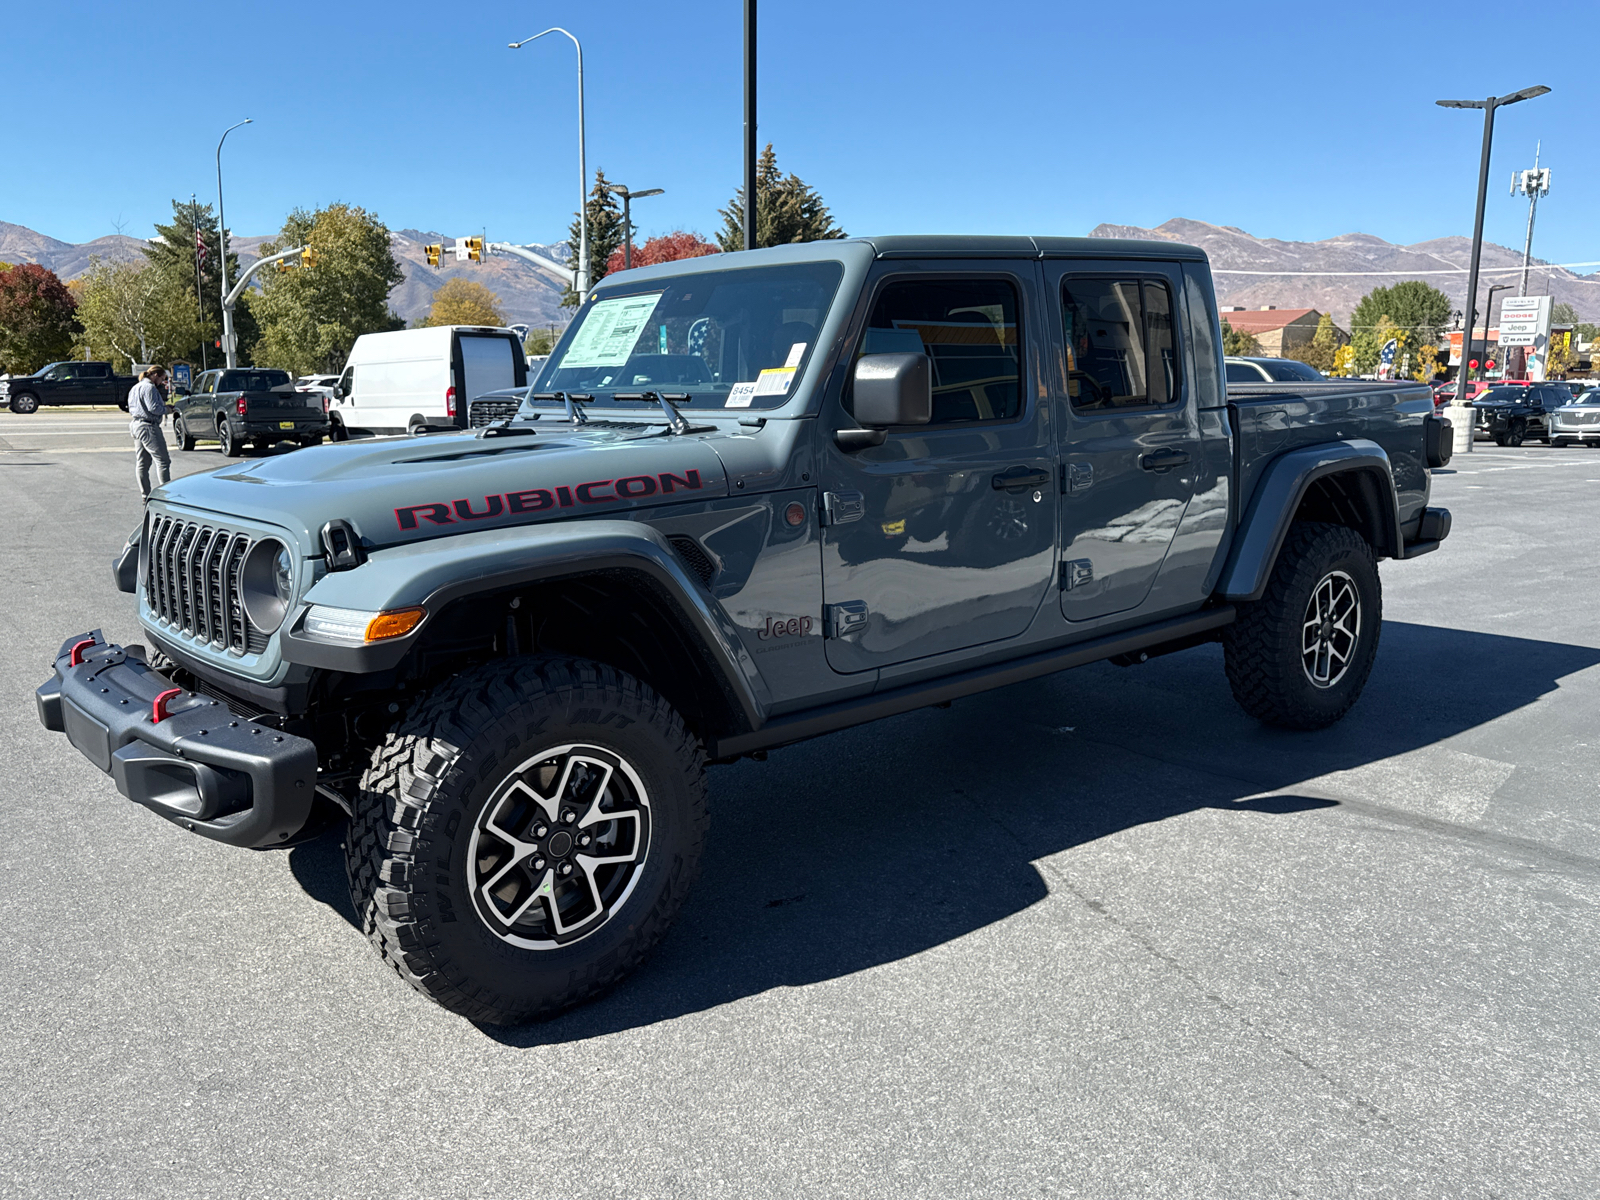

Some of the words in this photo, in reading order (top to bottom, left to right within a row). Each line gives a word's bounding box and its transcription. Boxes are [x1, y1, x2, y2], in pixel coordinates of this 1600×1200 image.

[733, 386, 754, 395] 8454
[394, 469, 703, 531] RUBICON
[758, 616, 813, 641] Jeep
[756, 641, 807, 654] GLADIATOR
[435, 715, 552, 924] WILDPEAK
[570, 708, 636, 729] M/T
